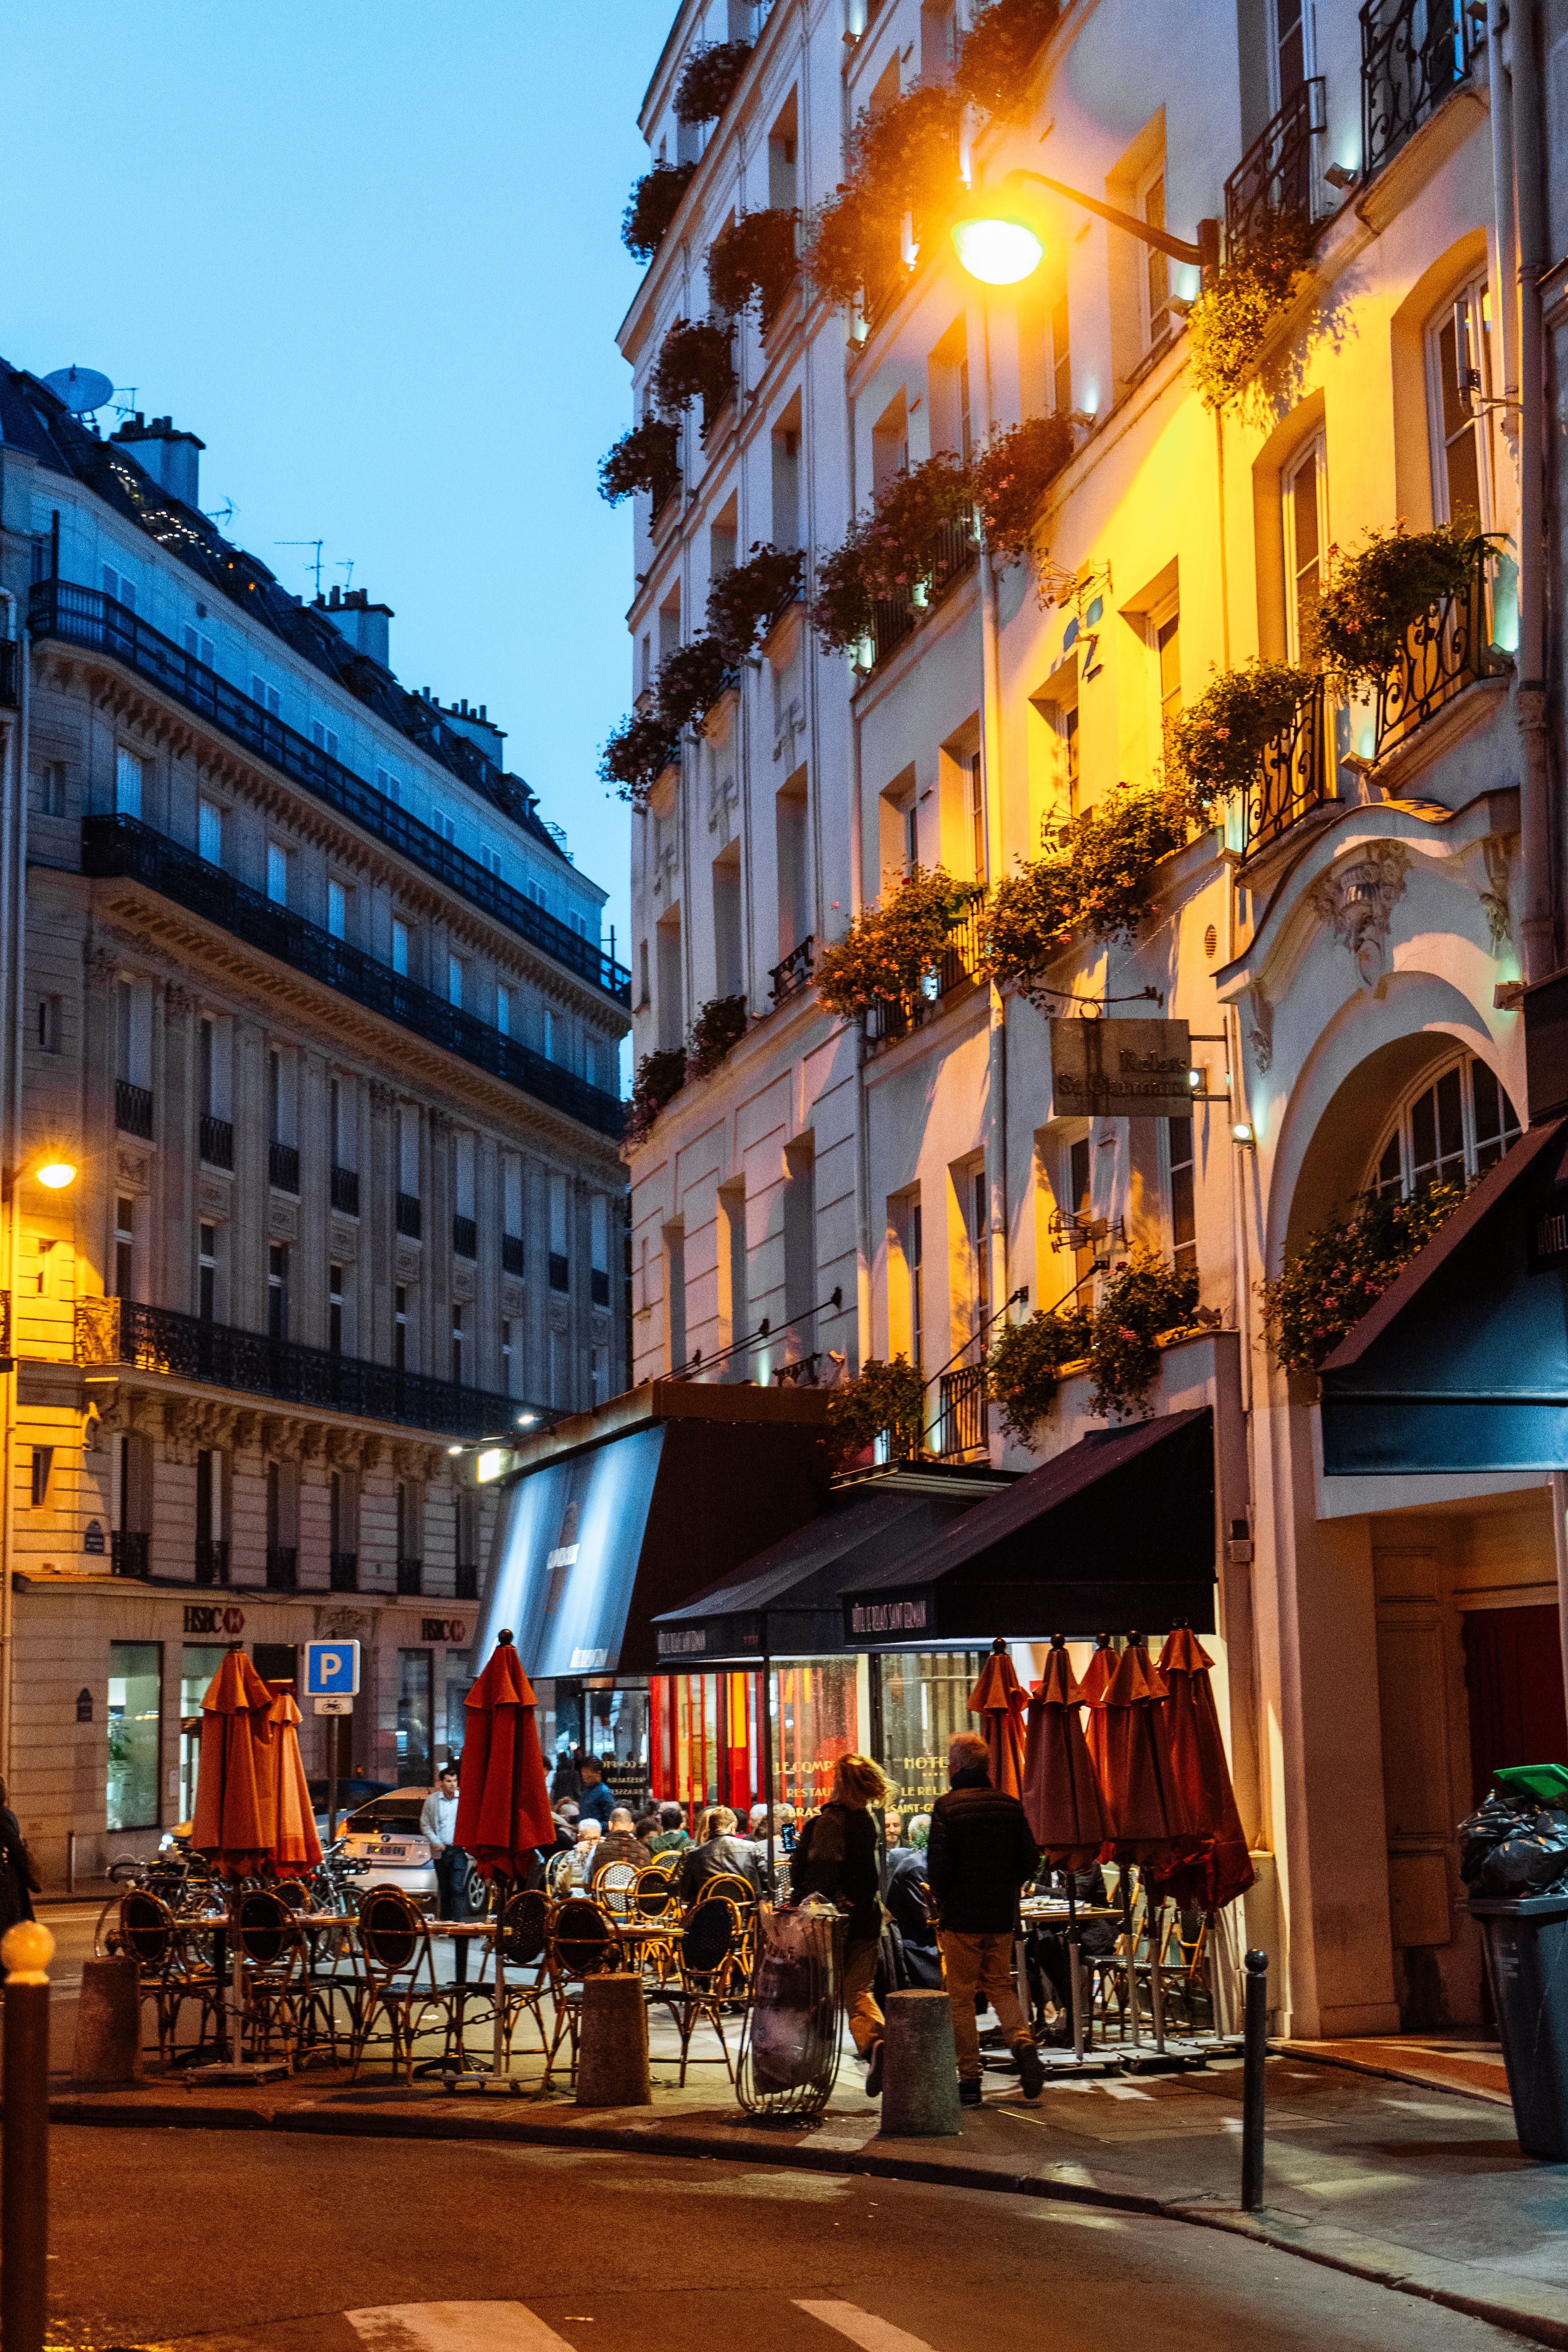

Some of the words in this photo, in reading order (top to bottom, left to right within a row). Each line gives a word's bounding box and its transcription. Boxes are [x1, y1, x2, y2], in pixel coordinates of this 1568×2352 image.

[183, 1606, 222, 1633] HSBC
[320, 1653, 342, 1685] P
[775, 1762, 790, 1772] LE
[901, 1787, 915, 1796] LE
